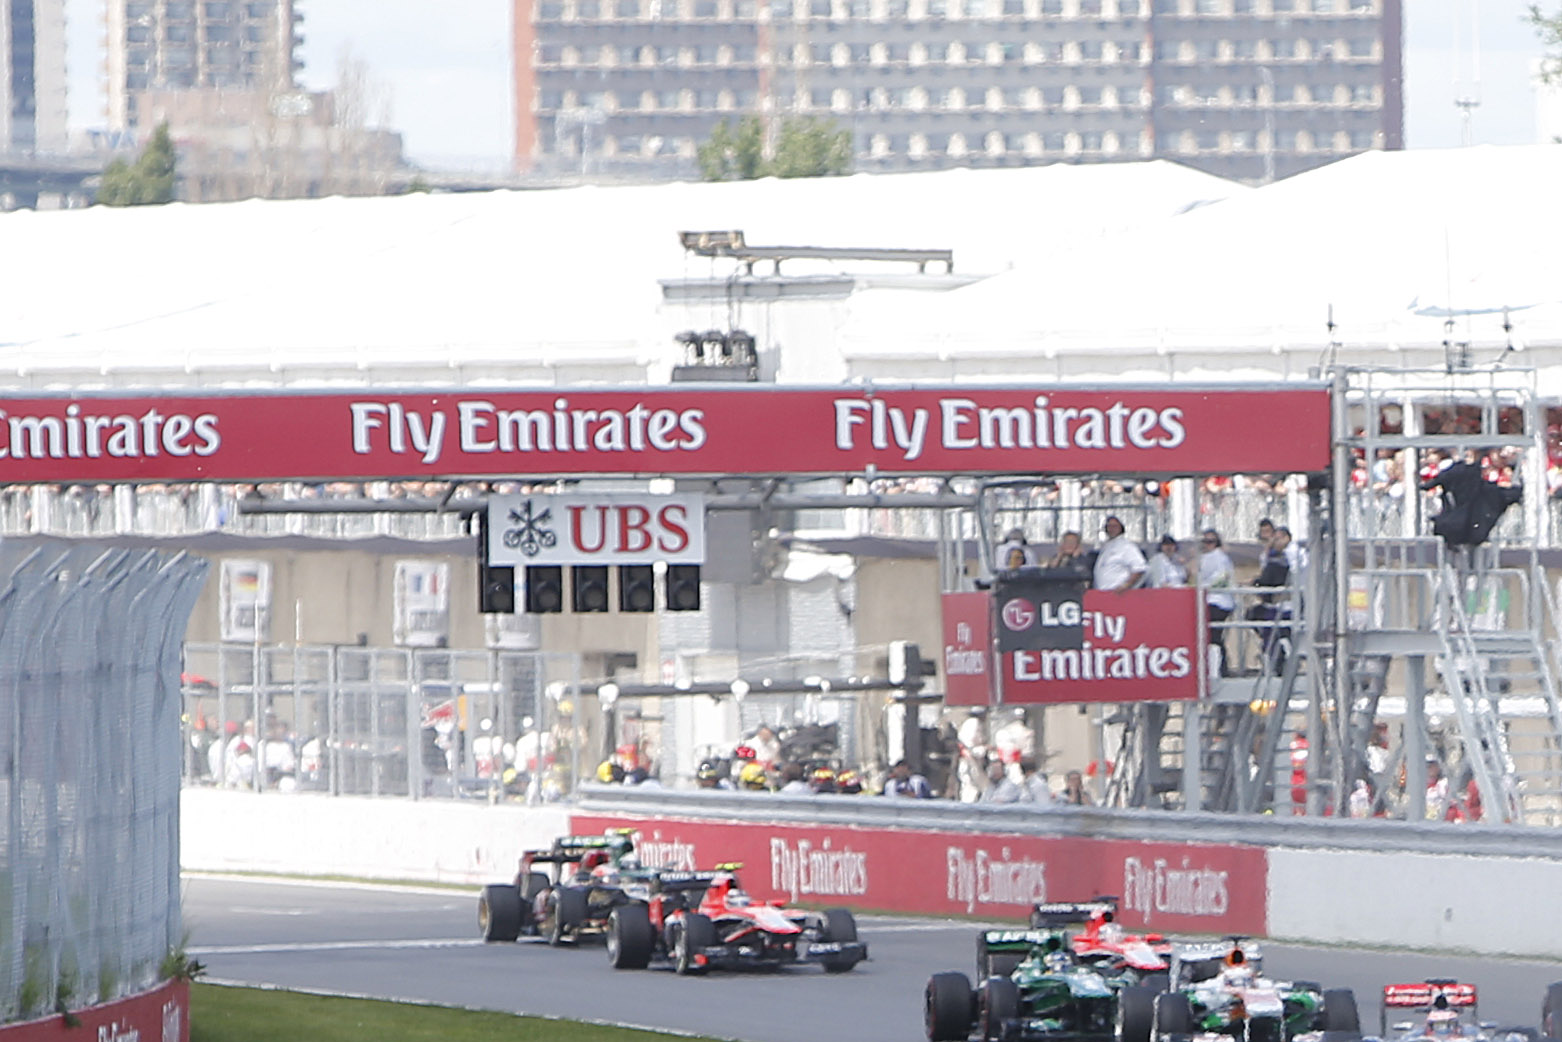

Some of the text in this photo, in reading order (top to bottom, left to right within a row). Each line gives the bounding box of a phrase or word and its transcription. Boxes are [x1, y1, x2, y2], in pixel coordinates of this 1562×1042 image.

[0, 404, 221, 459] mirates
[350, 397, 707, 464] Fly Emirates
[834, 395, 1186, 460] Fly Emirates
[565, 503, 690, 553] UBS
[1041, 601, 1082, 626] LG
[1013, 641, 1191, 682] Emirates
[770, 836, 867, 904] Fly Emirates
[947, 845, 1046, 914] Fly Emirates
[1124, 855, 1229, 924] Fly Emirates
